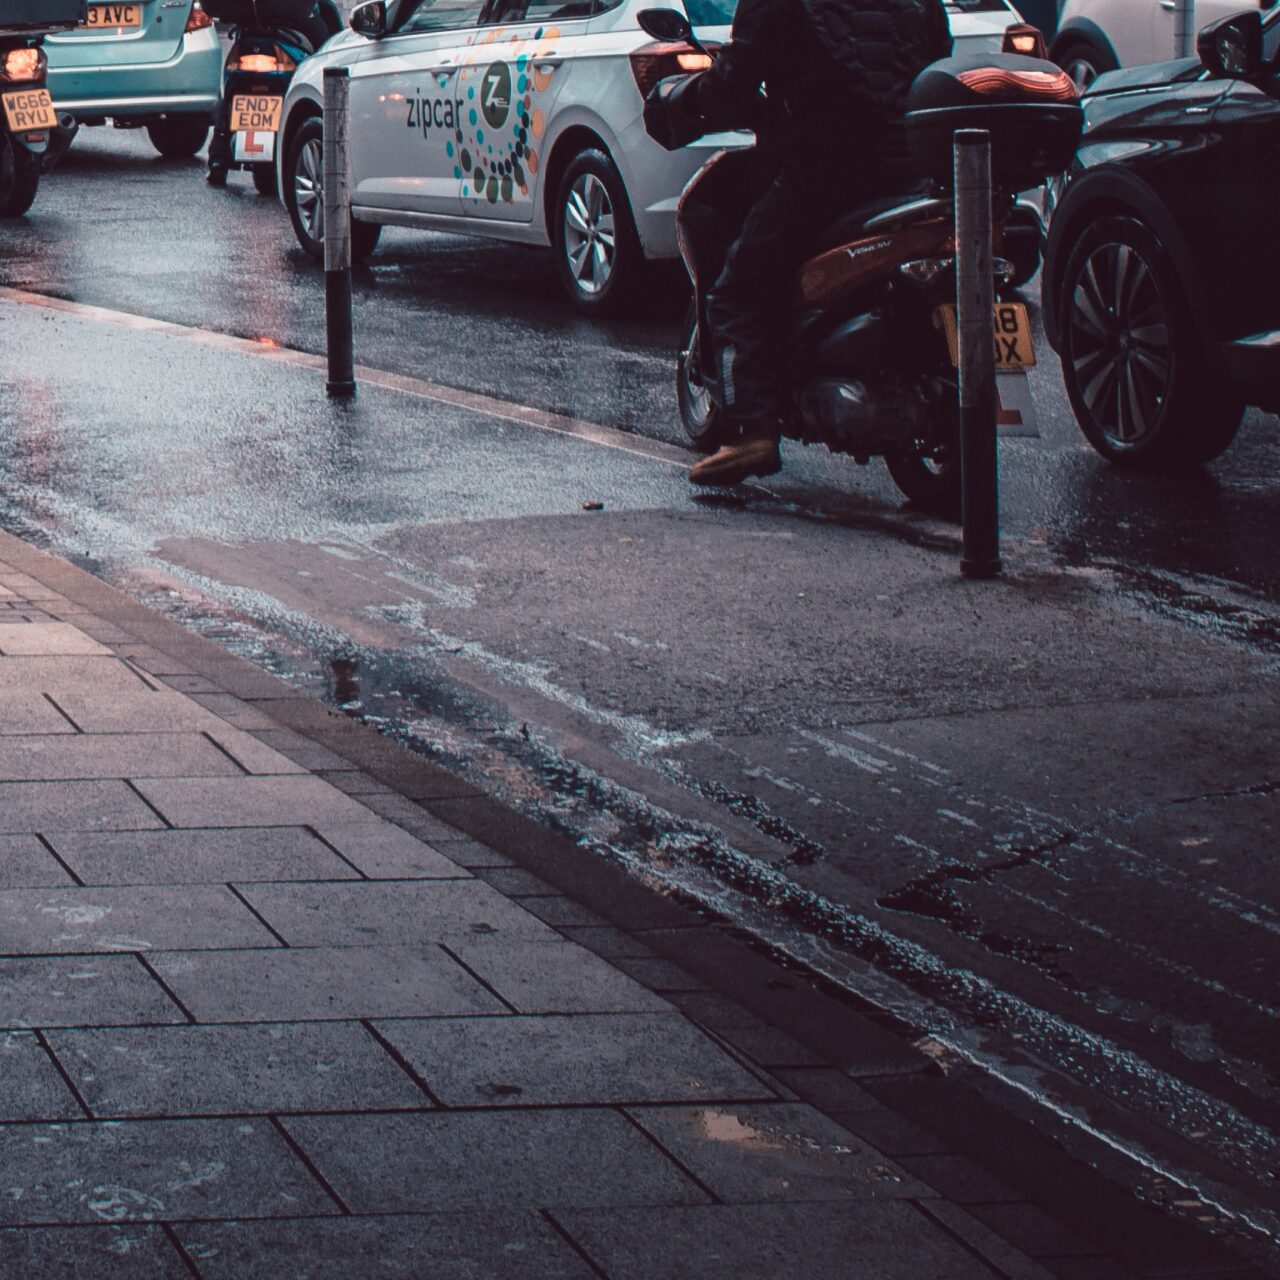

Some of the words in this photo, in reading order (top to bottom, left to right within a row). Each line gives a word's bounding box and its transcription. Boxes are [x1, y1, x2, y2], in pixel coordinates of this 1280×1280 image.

[103, 6, 134, 23] AVC
[5, 94, 50, 111] WG66
[235, 97, 280, 112] EN07
[14, 109, 48, 126] RYU
[240, 113, 273, 127] EOM
[406, 87, 464, 139] zipcar
[245, 130, 264, 153] L
